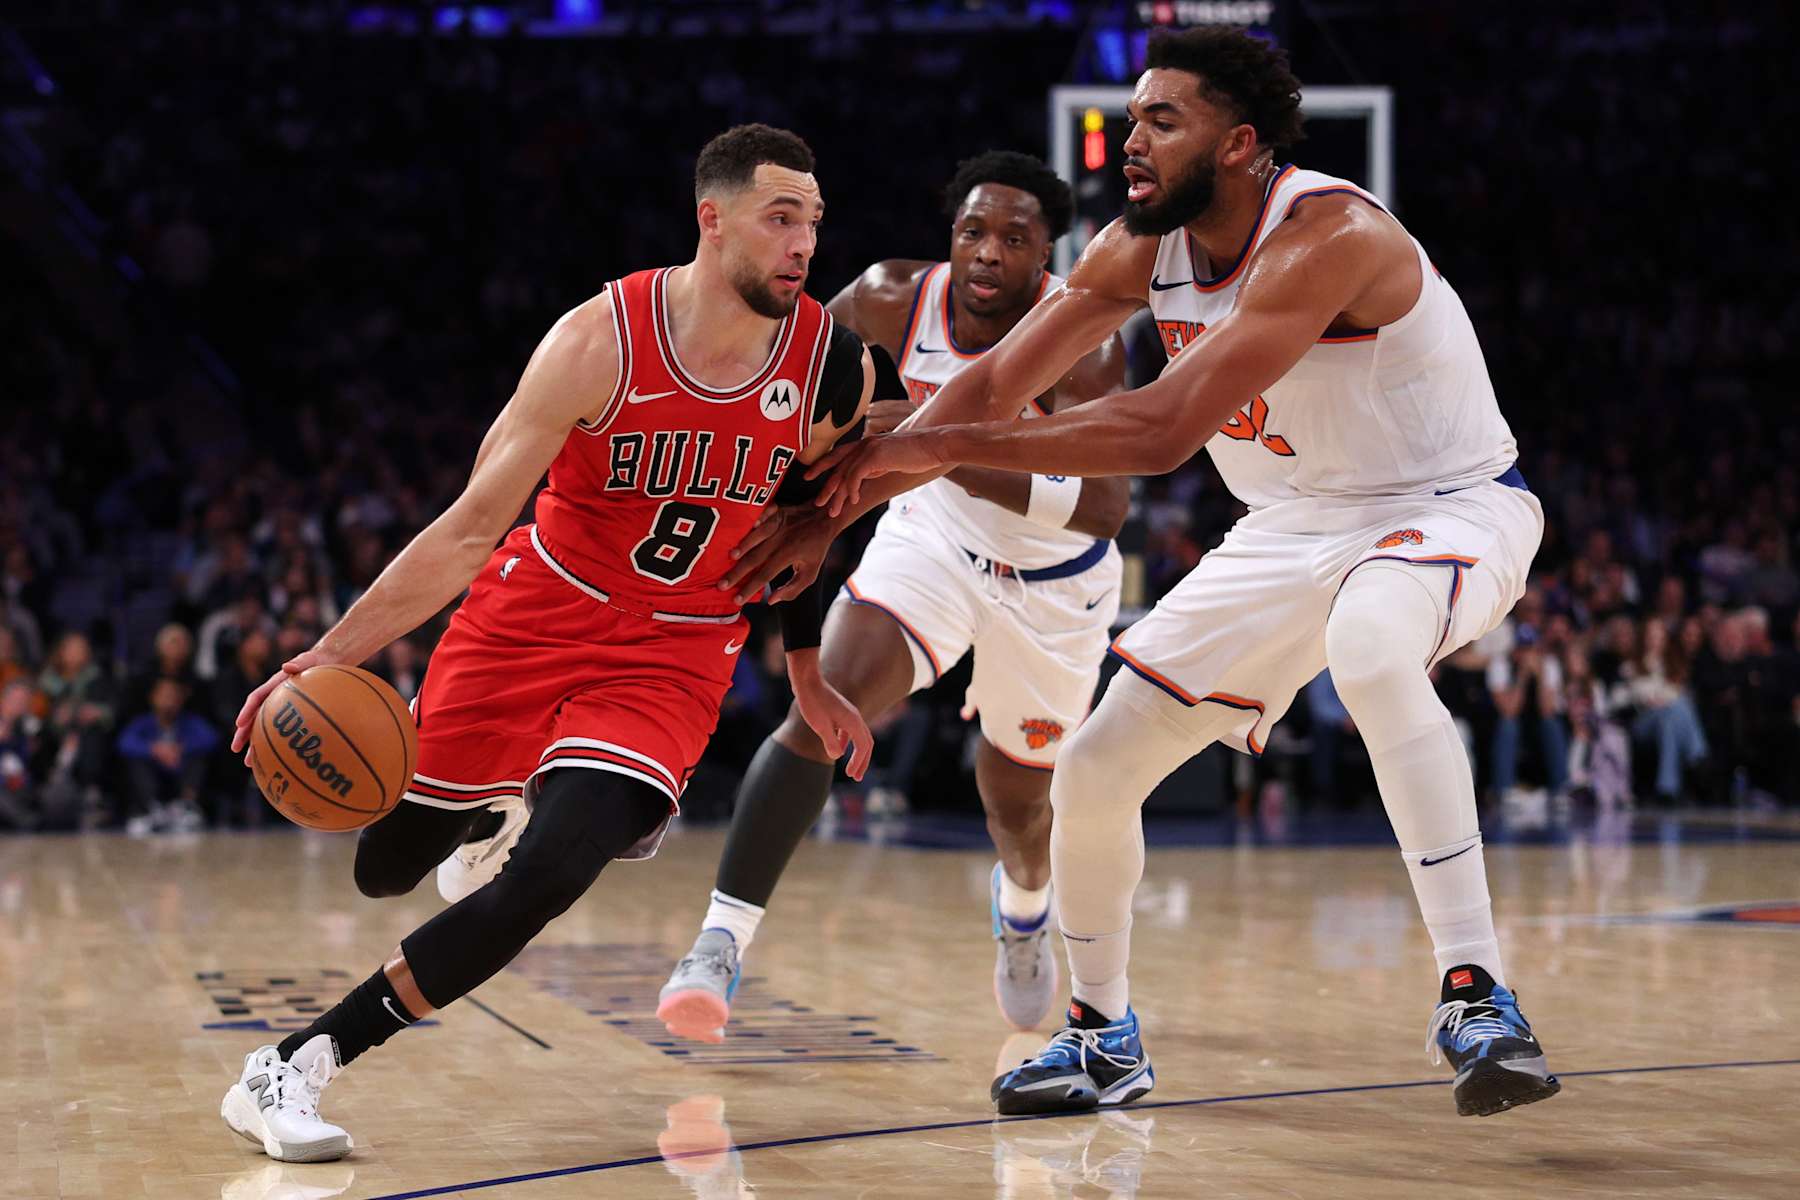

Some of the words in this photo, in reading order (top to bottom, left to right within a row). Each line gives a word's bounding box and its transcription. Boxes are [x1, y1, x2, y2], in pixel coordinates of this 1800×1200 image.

[604, 431, 795, 506] BULLS
[629, 500, 720, 586] 8
[272, 701, 353, 798] Wilson
